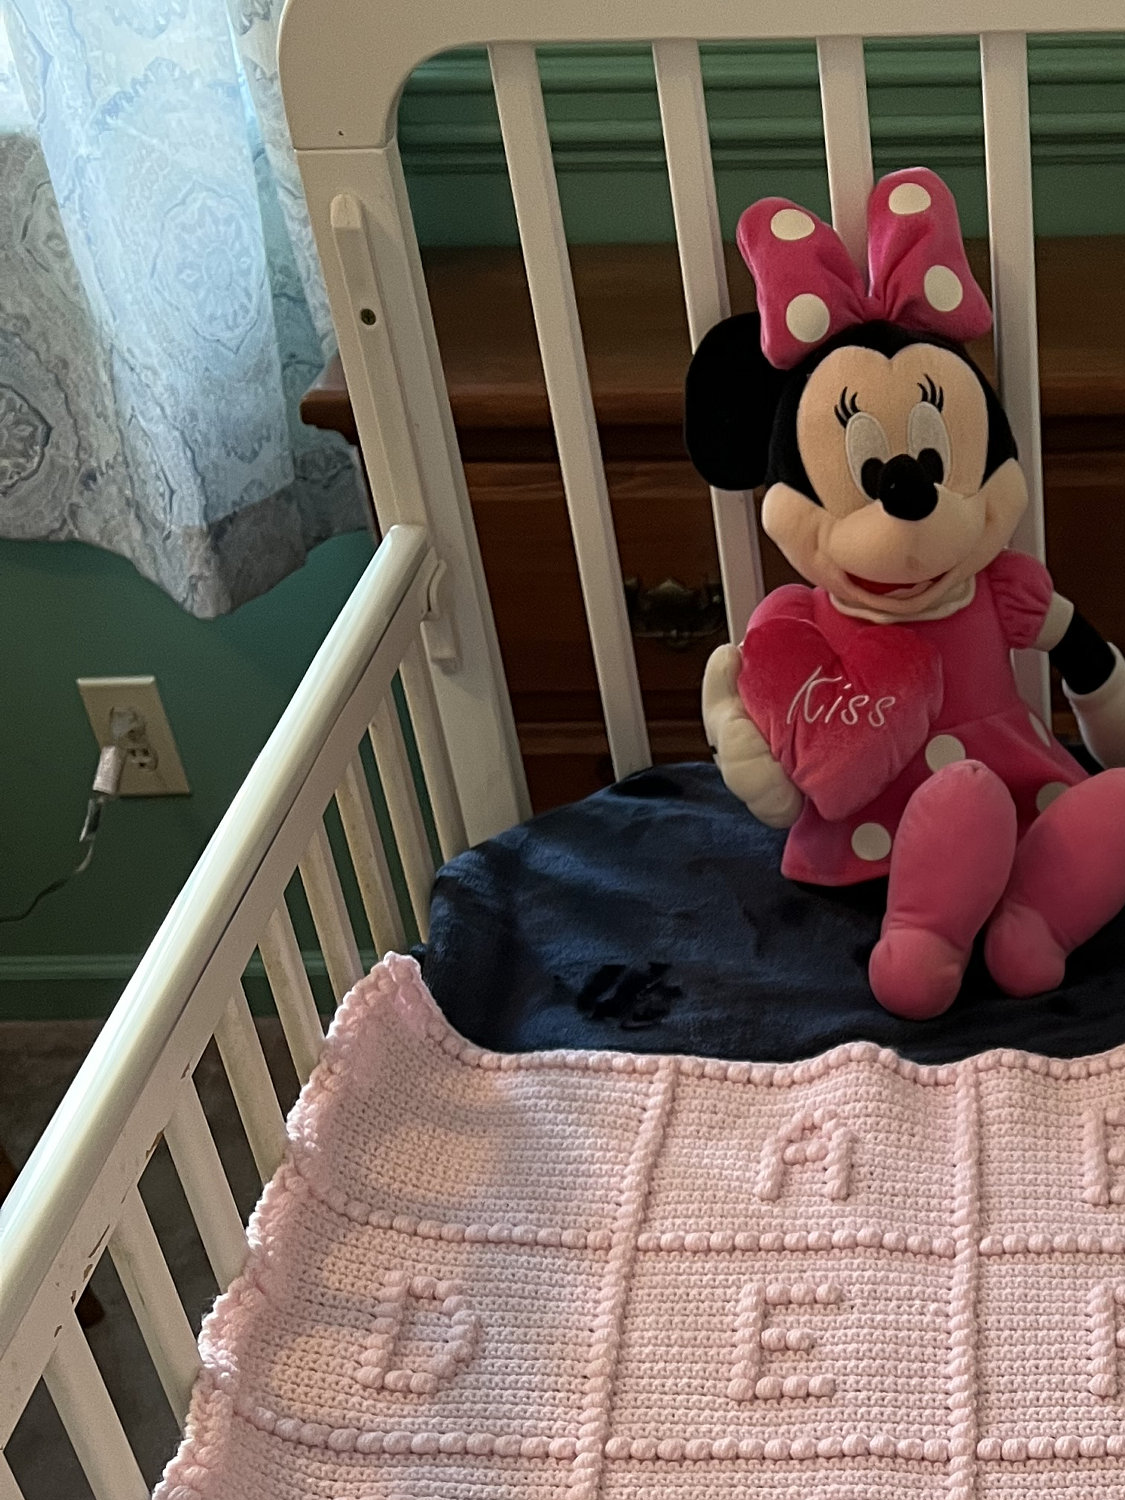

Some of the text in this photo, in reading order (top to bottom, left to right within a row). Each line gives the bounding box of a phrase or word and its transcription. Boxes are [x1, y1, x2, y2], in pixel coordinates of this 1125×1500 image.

[786, 665, 896, 727] Kiss
[753, 1109, 857, 1200] A
[354, 1271, 482, 1396] D
[727, 1281, 844, 1400] E
